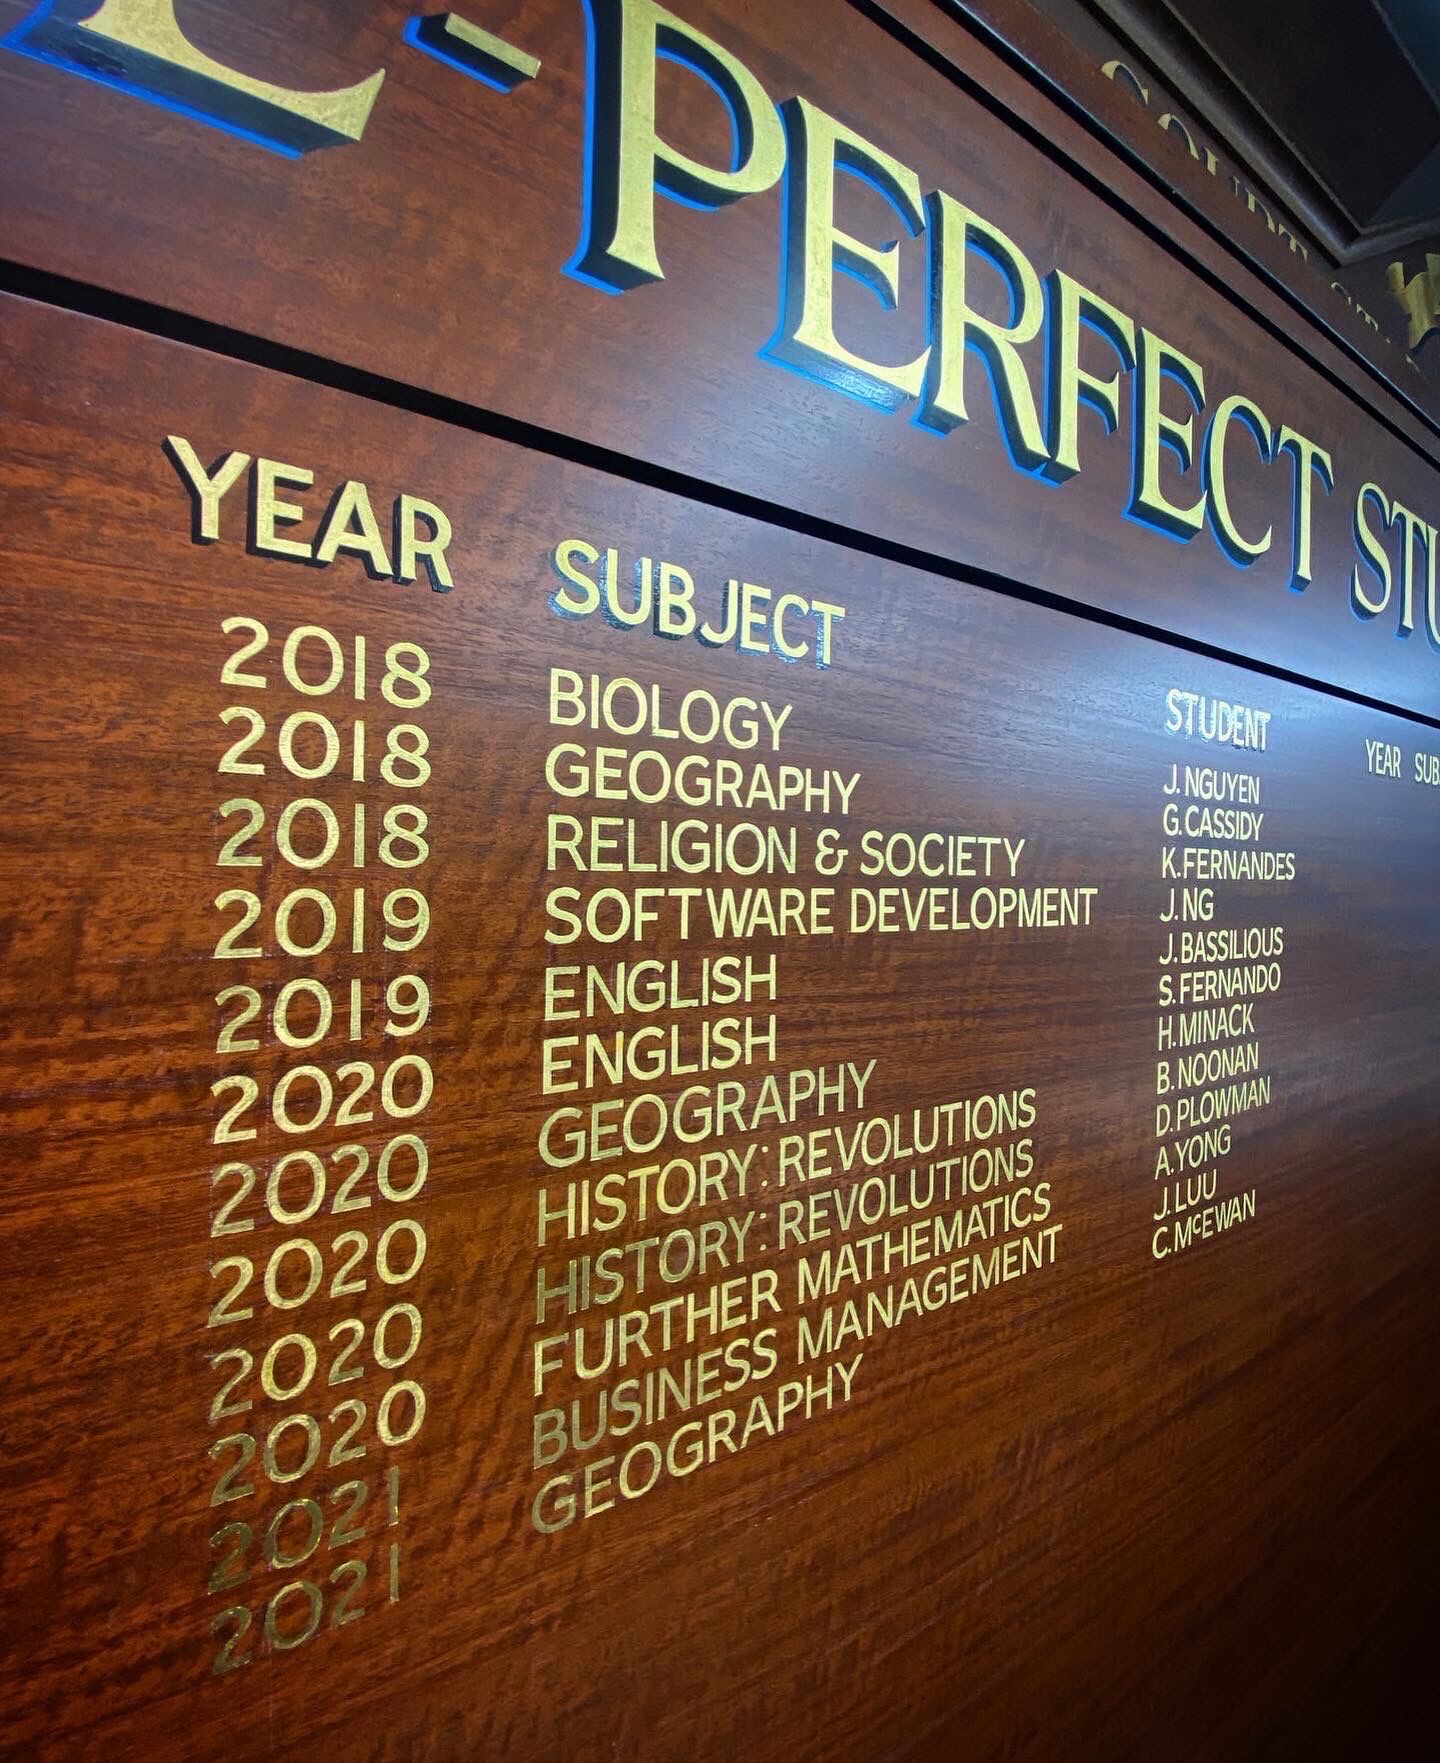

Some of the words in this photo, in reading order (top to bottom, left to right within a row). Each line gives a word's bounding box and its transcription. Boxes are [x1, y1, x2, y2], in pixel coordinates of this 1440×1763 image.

[162, 434, 453, 594] YEAR
[551, 539, 846, 669] SUBJECT
[1165, 688, 1271, 751] STUDENT
[218, 706, 432, 788] 2018
[545, 743, 860, 814] GEOGRAPHY
[220, 616, 432, 709] 2018
[549, 668, 792, 750] BIOLOGY
[216, 798, 430, 869] 2018
[547, 814, 796, 874] RELIGION
[815, 828, 848, 875] &
[860, 830, 1025, 877] SOCIETY
[1365, 738, 1401, 779] YEAR
[1414, 752, 1440, 787] SUB
[213, 888, 431, 959] 2019
[544, 888, 834, 944] SOFTWARE
[850, 888, 1098, 934] DEVELOPMENT
[210, 1054, 434, 1145] 2020
[542, 1014, 777, 1095] ENGLISH
[215, 974, 431, 1054] 2019
[544, 954, 777, 1021] ENGLISH
[207, 1218, 427, 1328] 2020
[778, 1088, 1036, 1186] REVOLUTIONS
[210, 1133, 429, 1238] 2020
[538, 1059, 877, 1168] GEOGRAPHY
[207, 1380, 426, 1507] 2020
[533, 1269, 782, 1397] FURTHER
[798, 1183, 1051, 1304] MATHEMATICS
[208, 1302, 422, 1422] 2020
[778, 1138, 1034, 1251] REVOLUTIONS
[207, 1465, 399, 1596] 2021
[532, 1328, 778, 1470] BUSINESS
[797, 1224, 1063, 1364] MANAGEMENT
[210, 1543, 400, 1676] 2021
[531, 1354, 863, 1534] GEOGRAPHY
